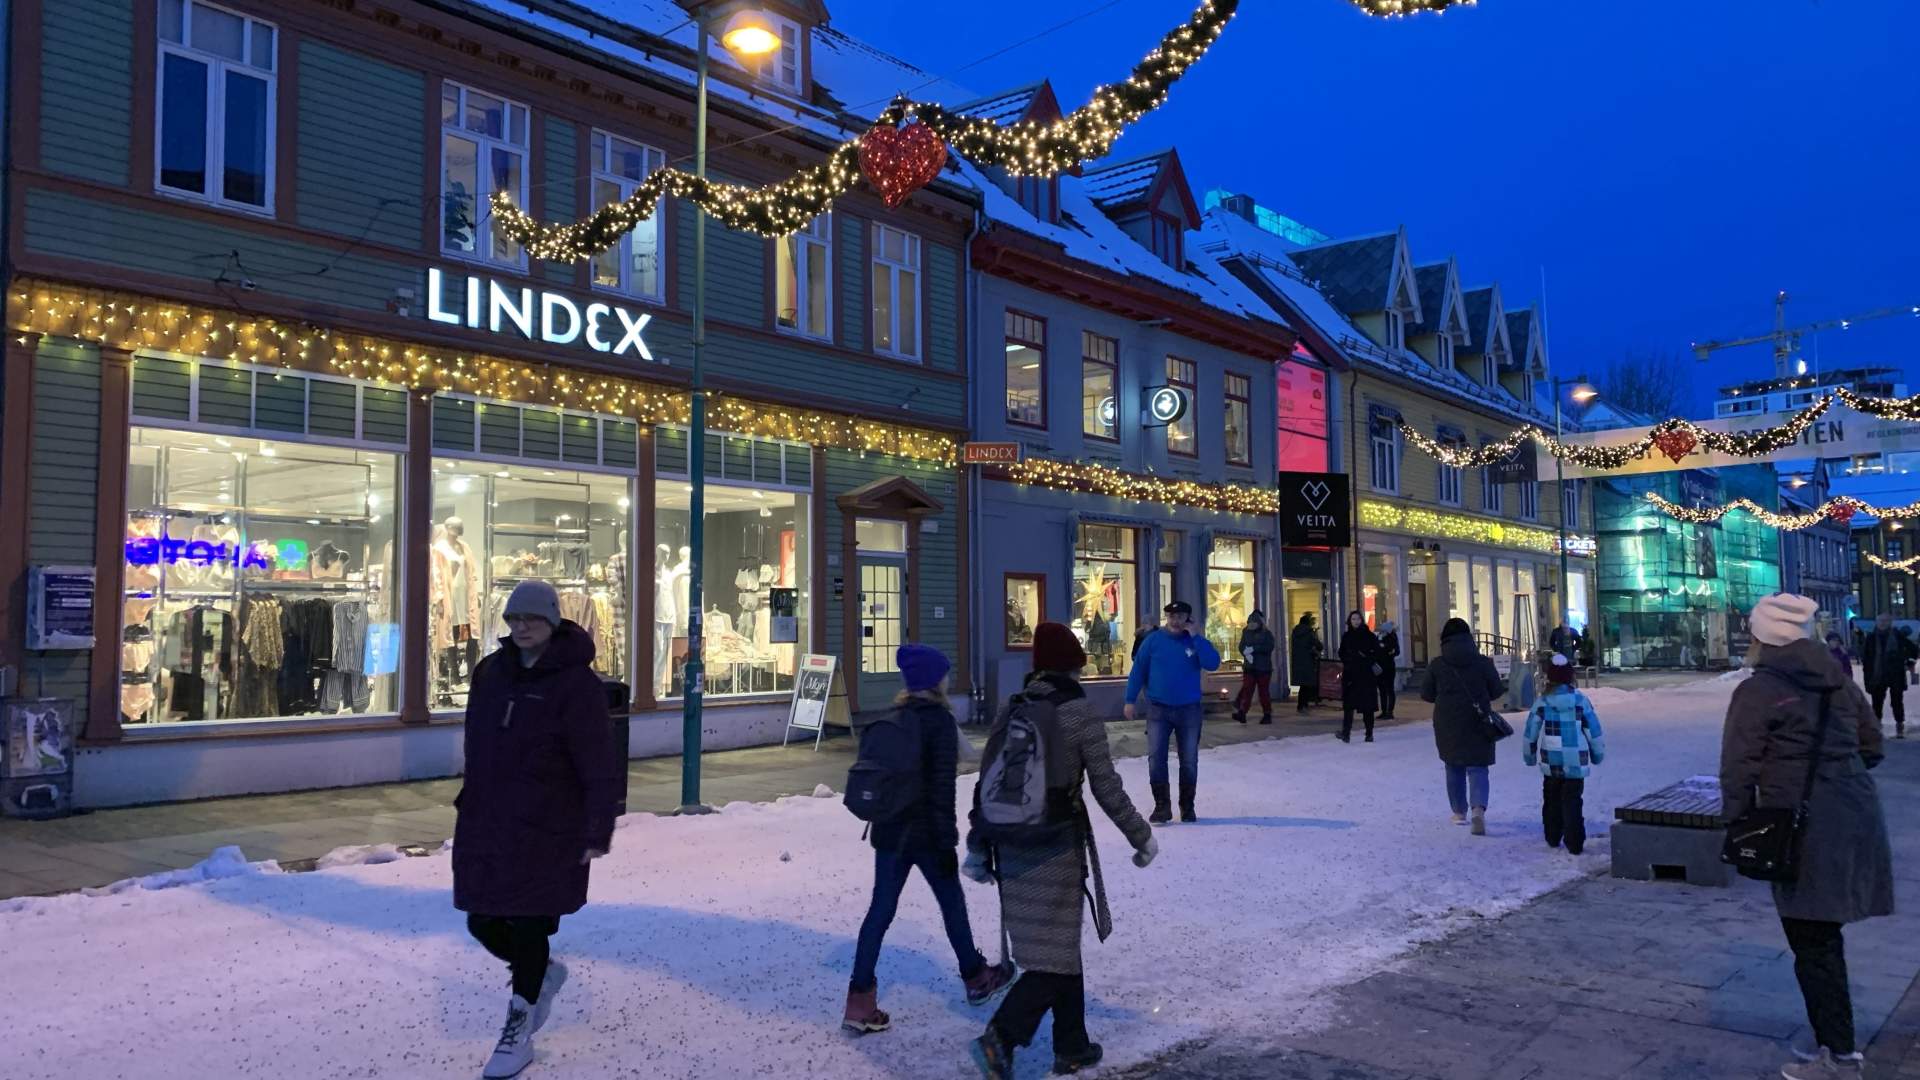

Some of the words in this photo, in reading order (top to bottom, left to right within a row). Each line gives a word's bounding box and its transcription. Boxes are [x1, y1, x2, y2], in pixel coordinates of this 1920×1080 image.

[428, 267, 654, 361] LINDEX
[969, 447, 1013, 459] LINDEX
[1500, 464, 1526, 472] VEITA
[1297, 514, 1337, 527] VEITA
